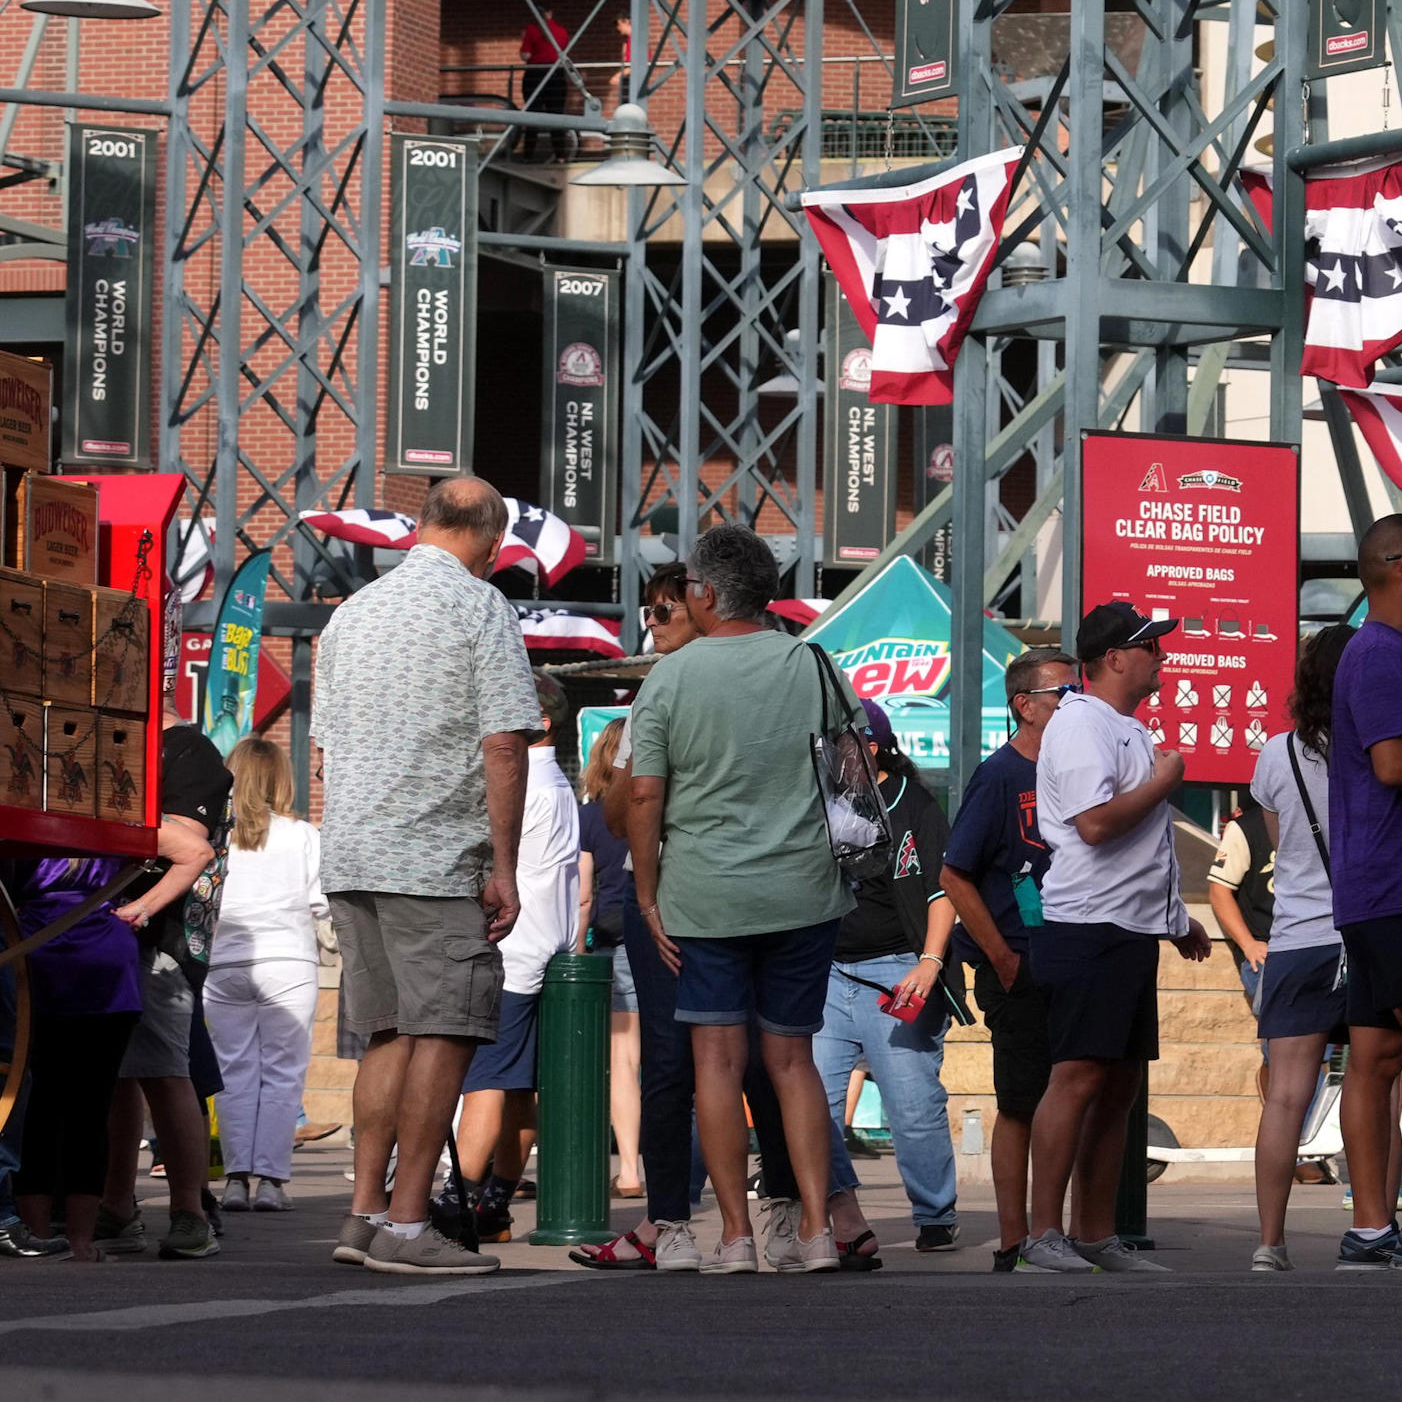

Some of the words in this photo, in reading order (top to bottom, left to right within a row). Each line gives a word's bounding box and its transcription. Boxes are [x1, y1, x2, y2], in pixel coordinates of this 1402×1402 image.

[88, 139, 136, 158] 2001
[410, 149, 456, 168] 2001
[560, 280, 604, 296] 2007
[112, 280, 126, 355] WORLD
[433, 289, 448, 365] WORLD
[92, 279, 109, 401] CHAMPIONS
[415, 288, 431, 410] CHAMPIONS
[581, 402, 593, 427] NL
[863, 407, 875, 432] NL
[564, 401, 578, 508] CHAMPIONS
[580, 430, 592, 481] WEST
[848, 406, 861, 513] CHAMPIONS
[862, 435, 875, 487] WEST
[34, 501, 90, 553] BUDWEISER
[1139, 501, 1193, 521] CHASE
[1198, 504, 1241, 524] FIELD
[1115, 519, 1166, 540] CLEAR
[1171, 523, 1204, 542] BAG
[1208, 525, 1265, 545] POLICY
[1146, 565, 1203, 581] APPROVED
[1206, 568, 1235, 582] BAGS
[1163, 653, 1215, 667] PPROVED
[1218, 655, 1246, 669] BAGS
